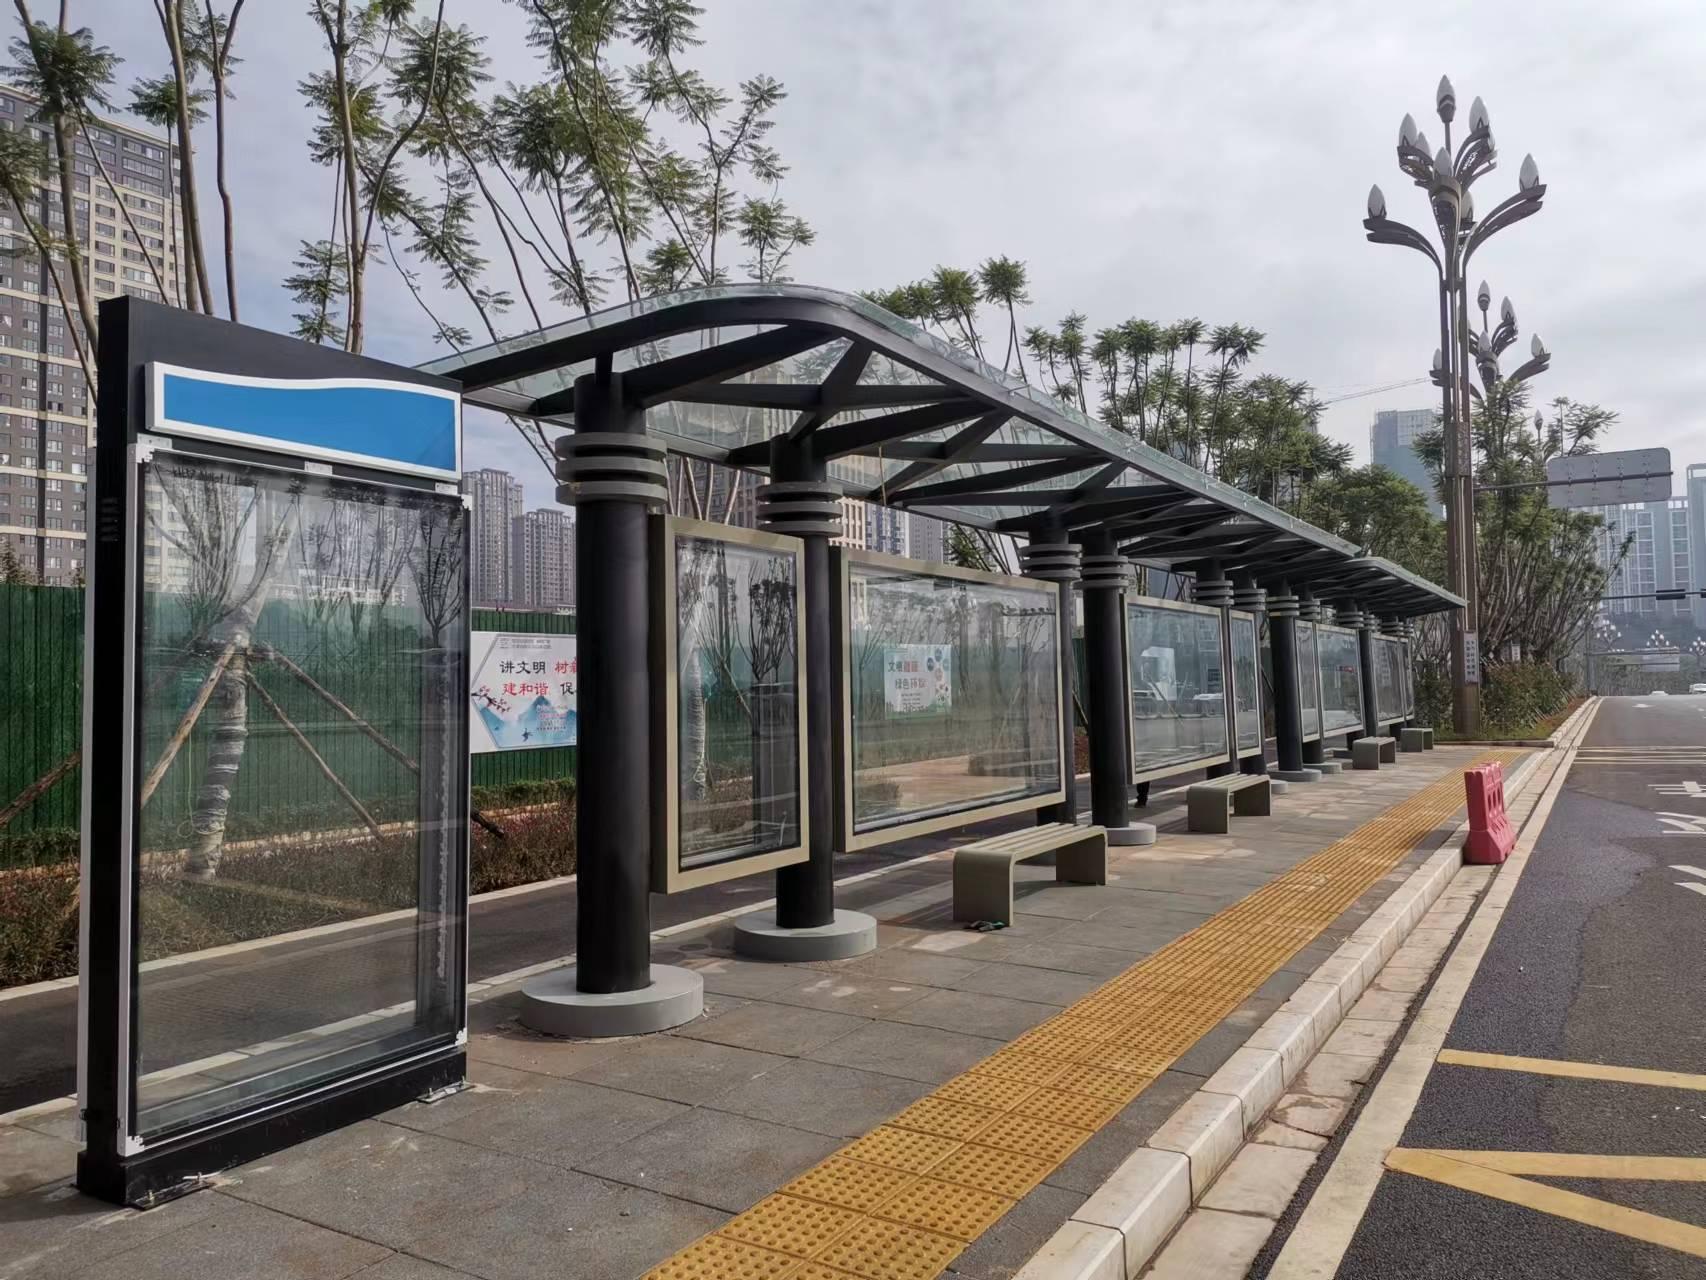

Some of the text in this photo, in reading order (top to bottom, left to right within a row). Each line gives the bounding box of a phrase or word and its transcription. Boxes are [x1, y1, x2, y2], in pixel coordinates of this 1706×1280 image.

[499, 660, 546, 675] 讲文明
[502, 681, 577, 696] 建和谐 促
